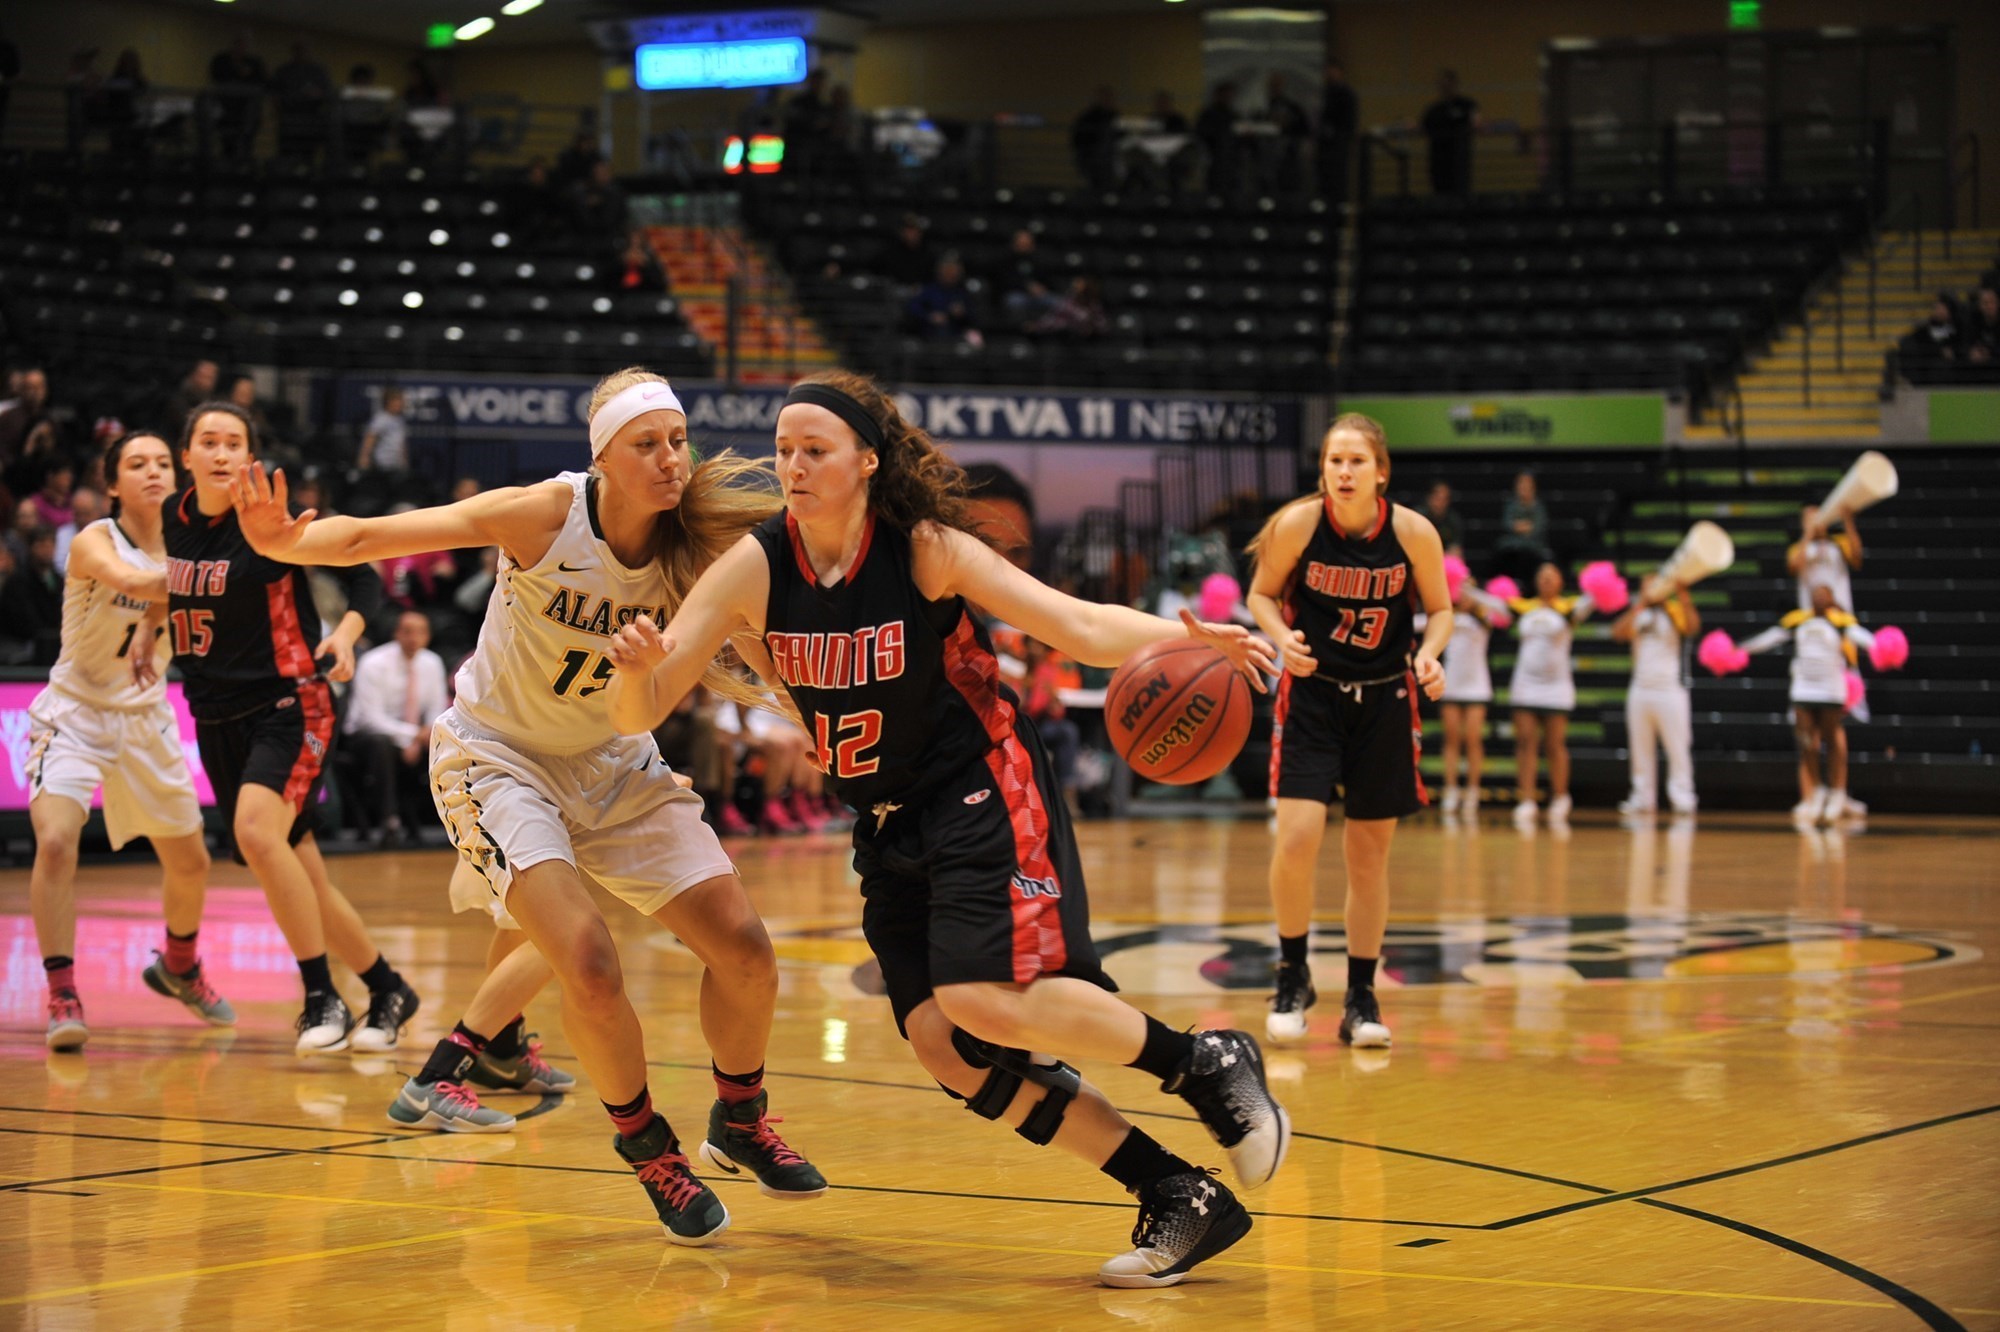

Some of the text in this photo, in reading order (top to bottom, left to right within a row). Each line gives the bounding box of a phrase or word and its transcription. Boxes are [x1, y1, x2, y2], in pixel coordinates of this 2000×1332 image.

[447, 387, 570, 426] VOICE
[927, 395, 1278, 442] KTVA 11 NEWS
[166, 556, 230, 596] INTS
[1305, 561, 1406, 600] SAINTS
[170, 608, 217, 658] 15
[1330, 606, 1389, 650] 13
[765, 620, 905, 690] SAINTS
[1140, 691, 1217, 767] Wilson
